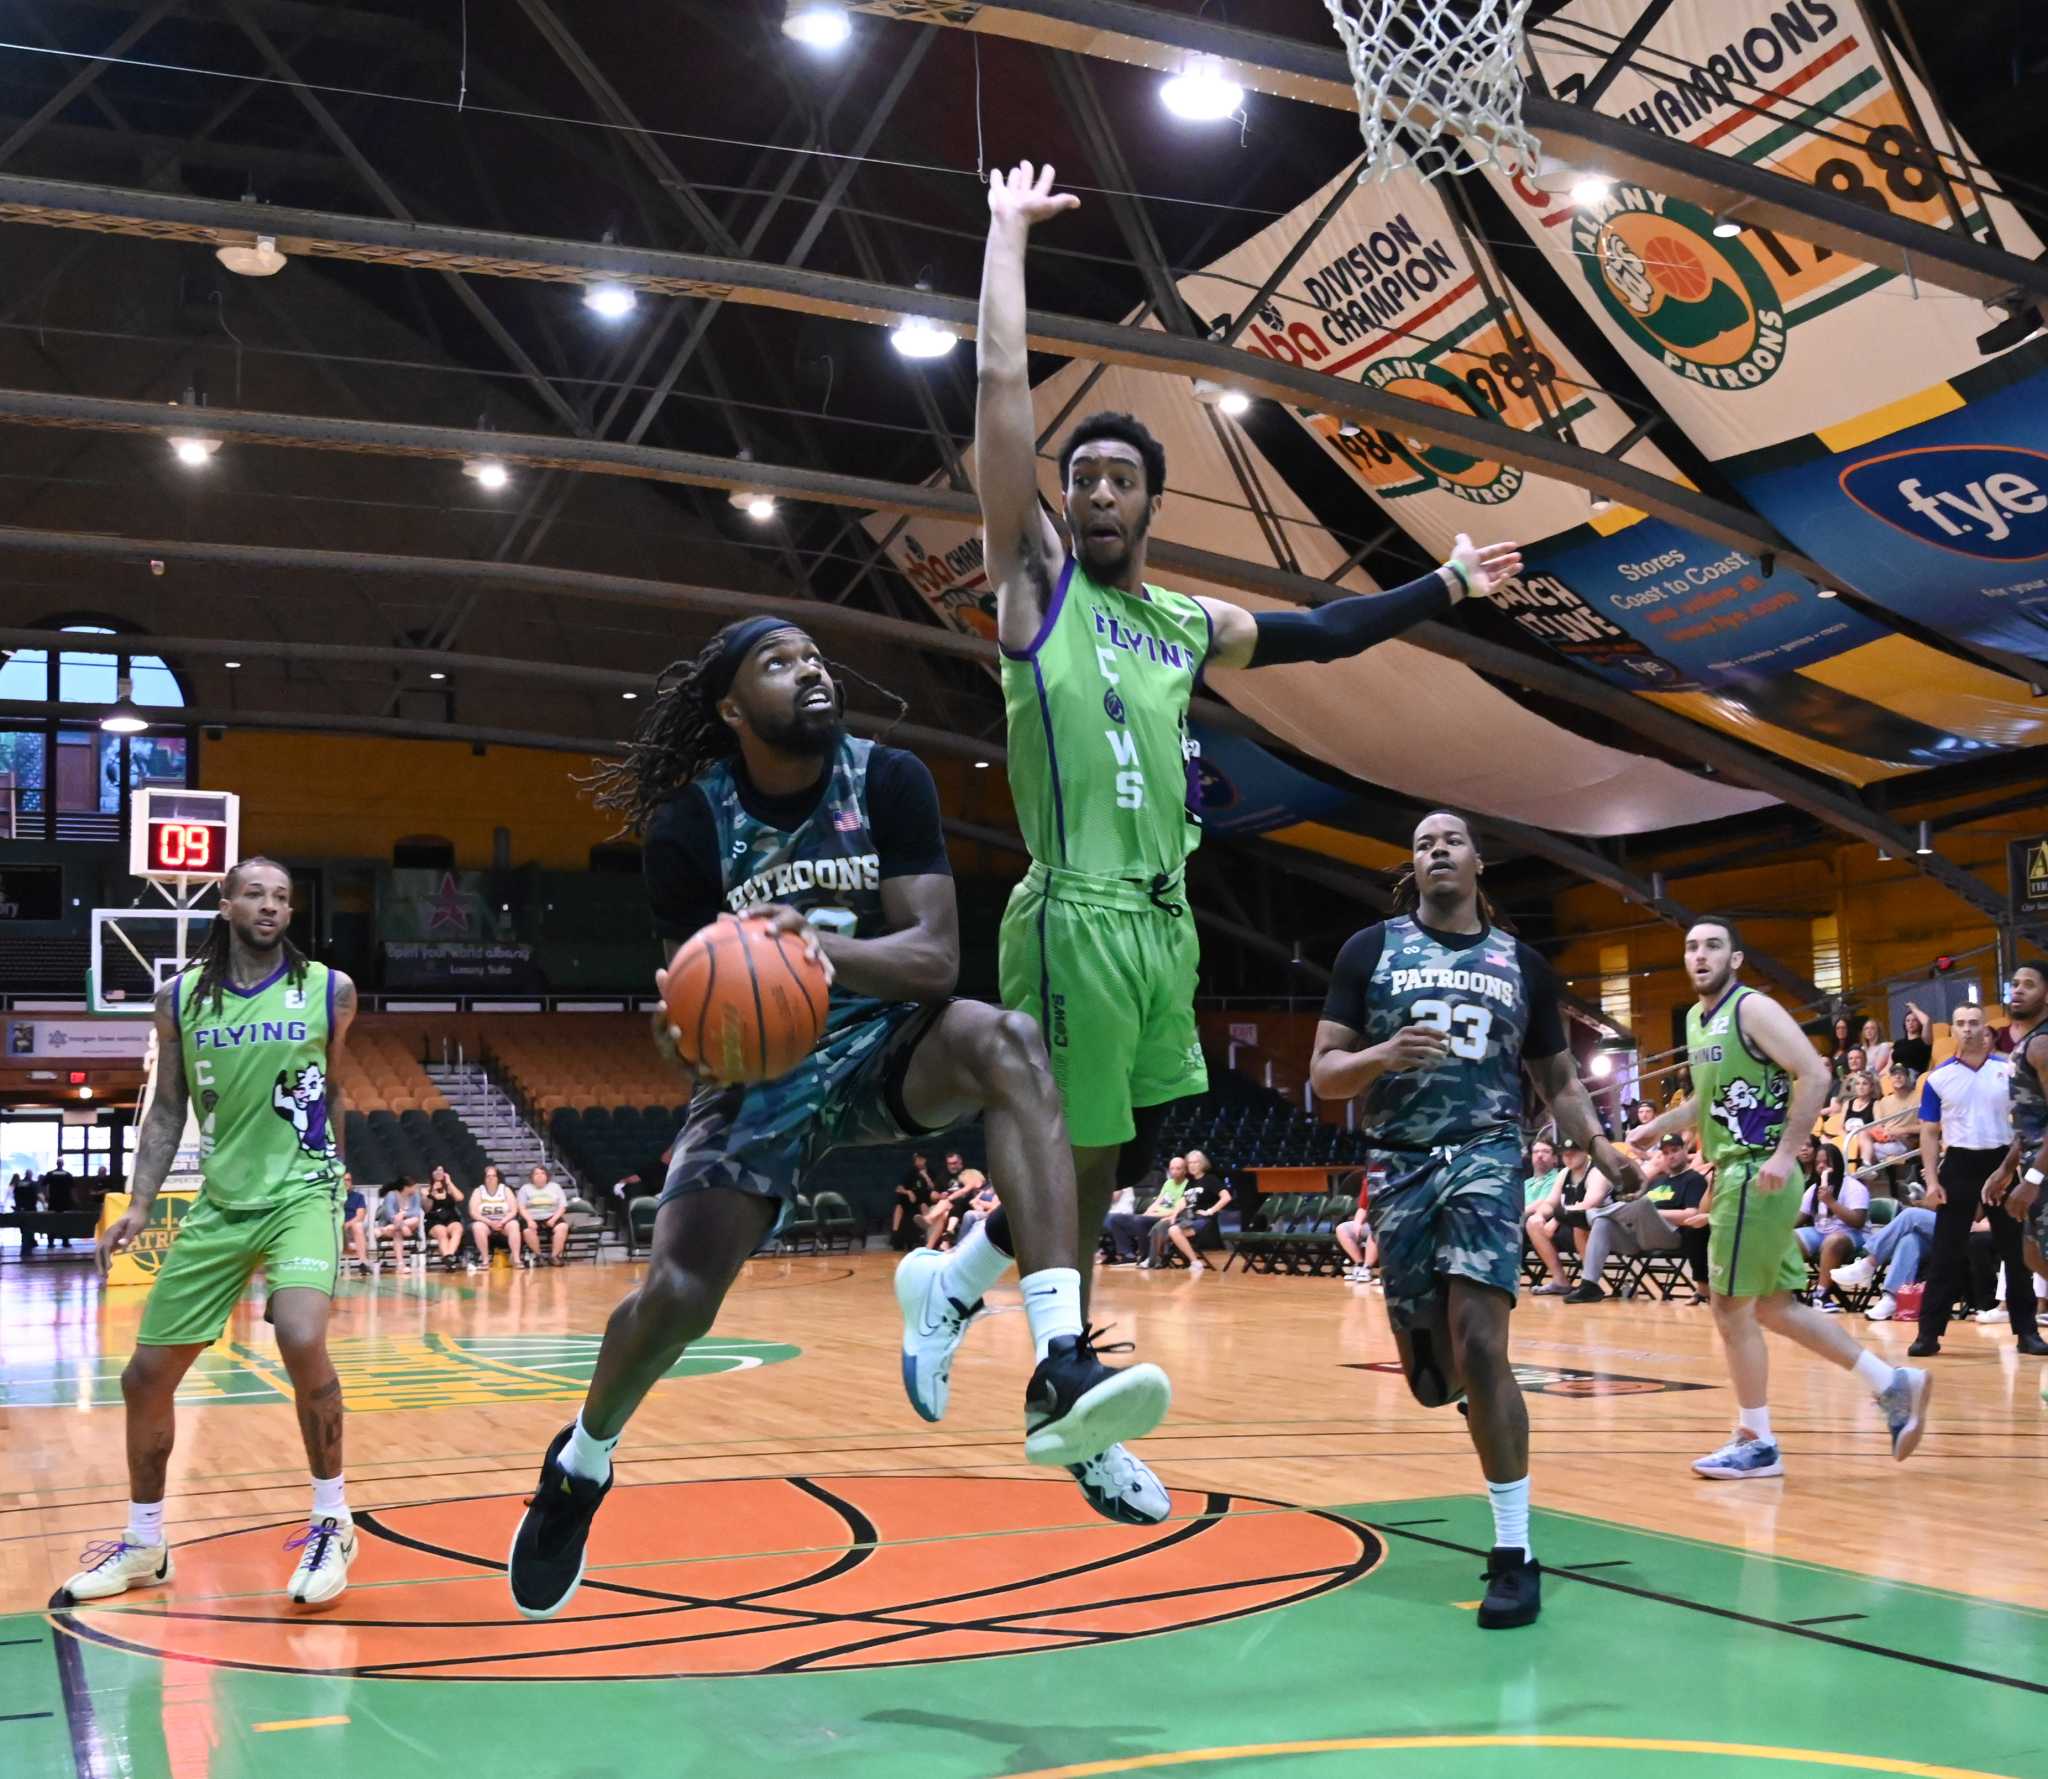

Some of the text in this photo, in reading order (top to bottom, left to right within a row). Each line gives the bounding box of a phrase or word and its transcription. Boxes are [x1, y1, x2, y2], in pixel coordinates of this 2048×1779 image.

[1618, 0, 1838, 138] HAMPIONS
[1303, 213, 1421, 308] DIVISION
[1321, 239, 1457, 346] CHAMPION
[1664, 309, 1784, 389] PATROONS
[1609, 551, 1750, 610] Coast to Coast
[1617, 548, 1686, 582] Stores
[1542, 606, 1622, 643] LIVE
[161, 824, 209, 866] 09
[1391, 968, 1514, 1007] PATROONS
[193, 1020, 308, 1050] FLYING
